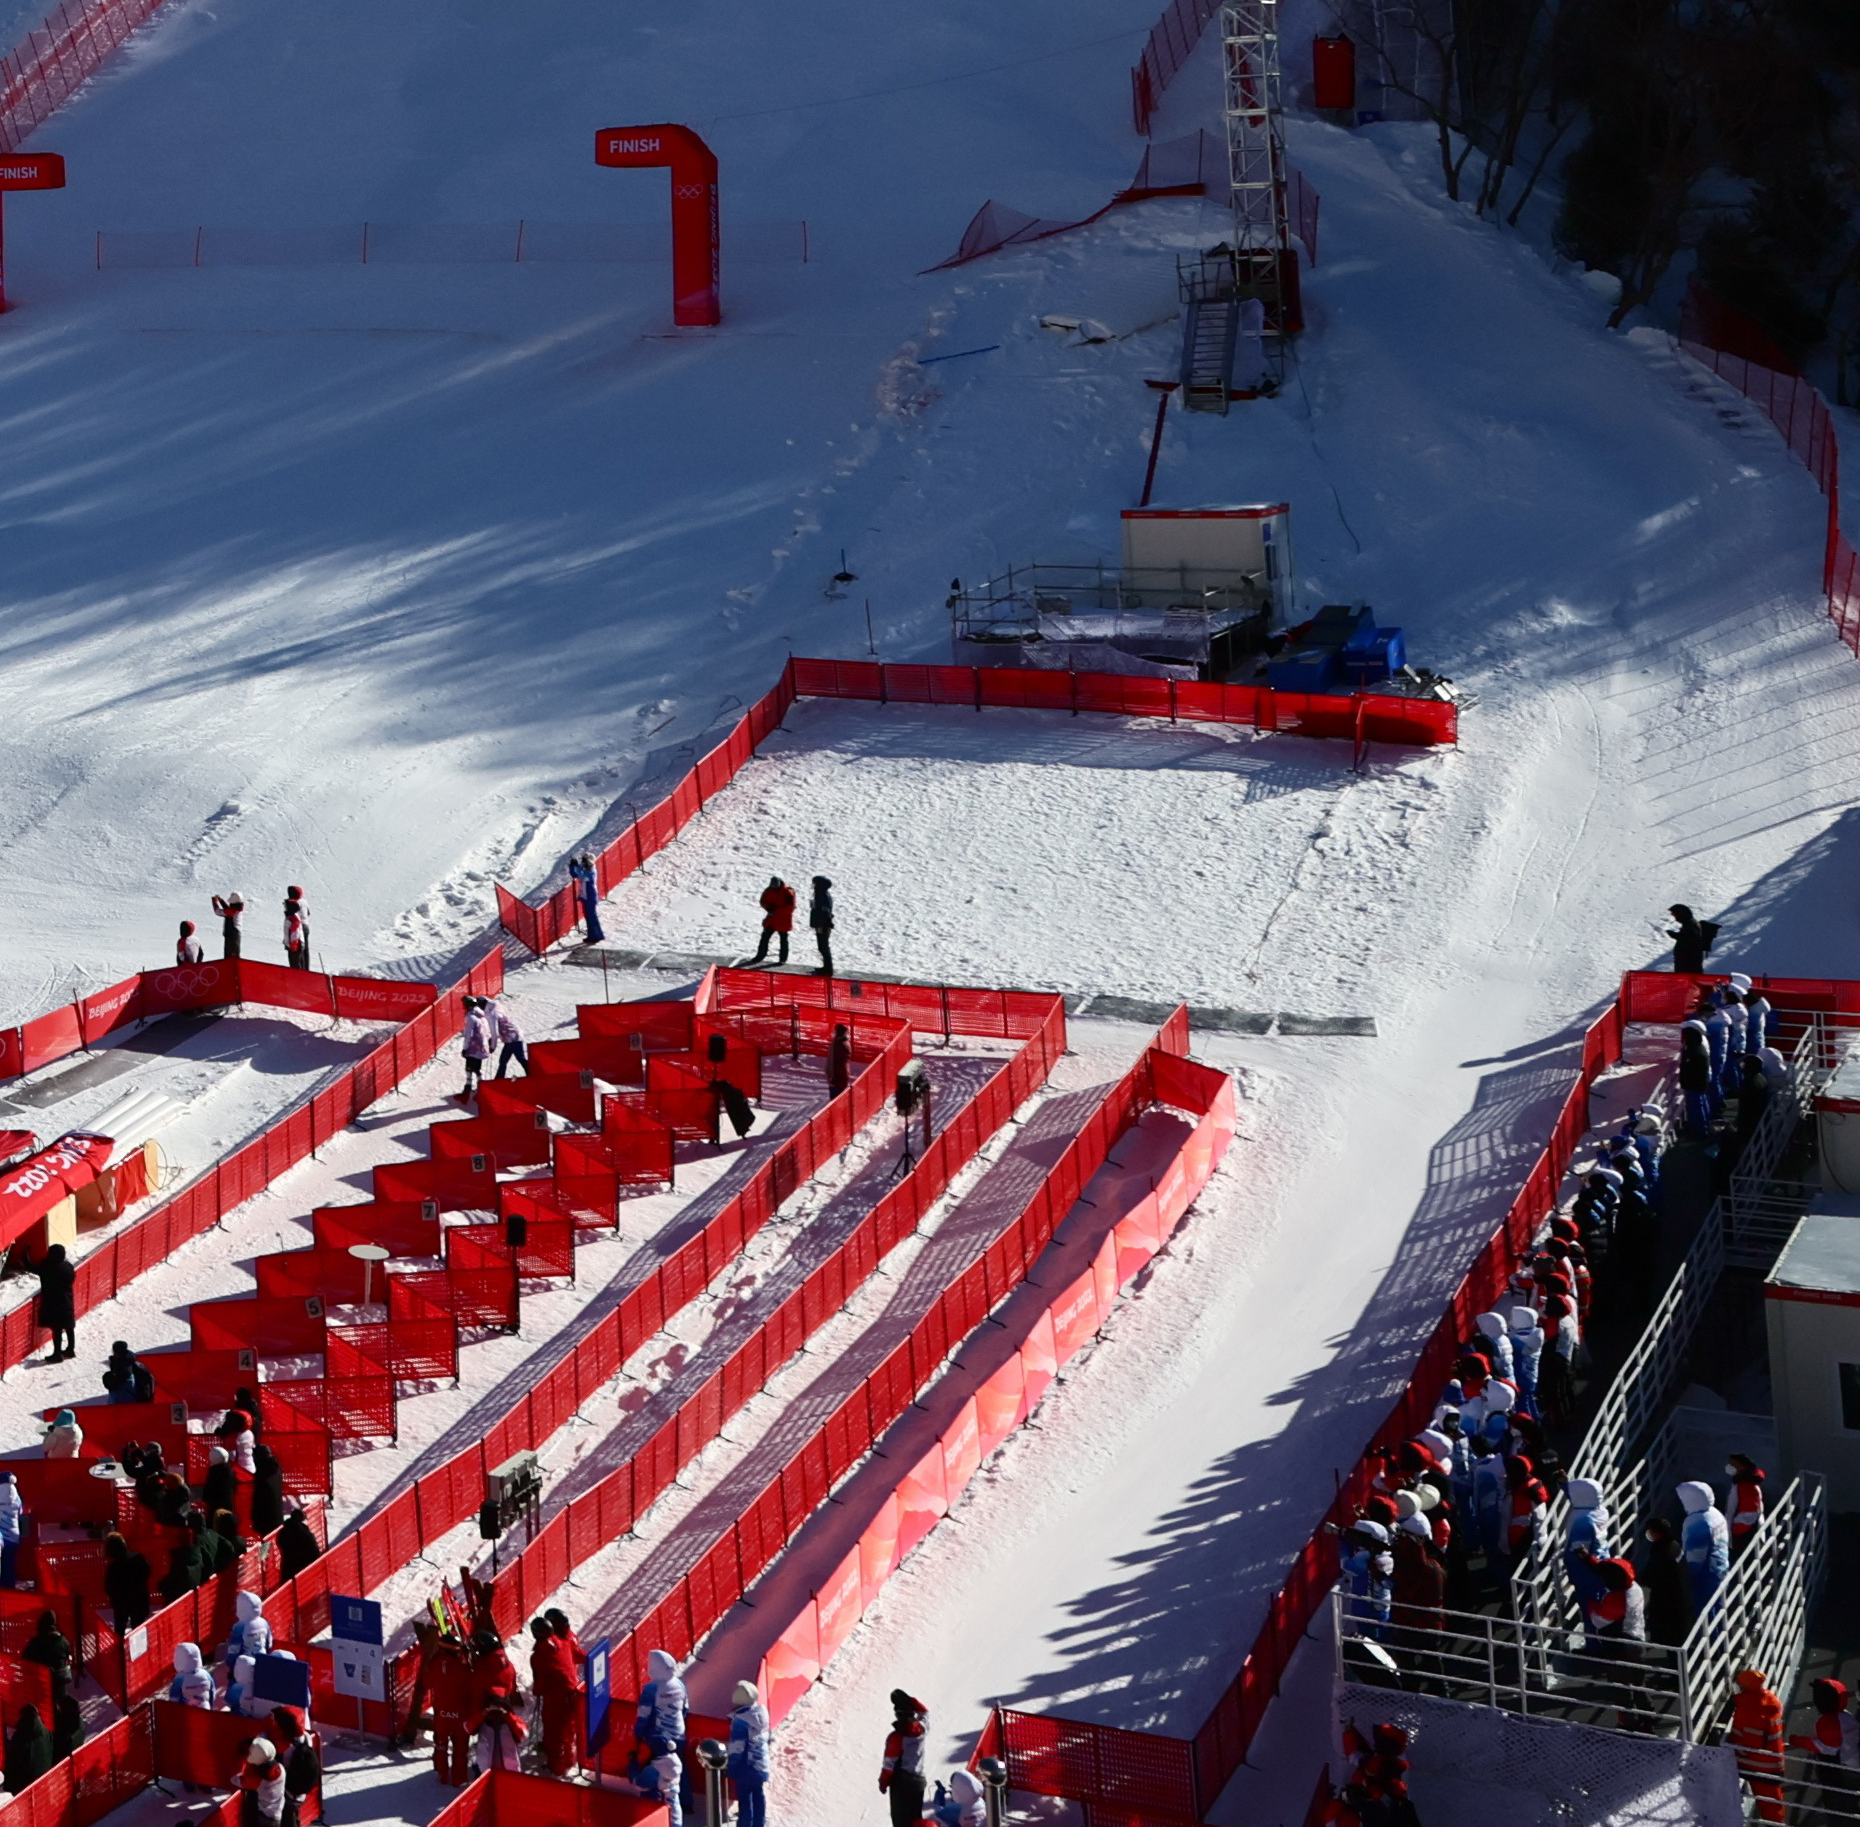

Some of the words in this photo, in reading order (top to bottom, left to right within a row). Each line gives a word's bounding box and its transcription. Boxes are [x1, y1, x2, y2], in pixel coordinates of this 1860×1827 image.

[610, 138, 660, 153] FINISH
[338, 986, 387, 1003] BEIJING
[391, 991, 429, 1004] 2022
[89, 996, 119, 1020] BEIJING
[474, 1156, 481, 1171] 8
[425, 1204, 435, 1219] 7
[309, 1300, 321, 1315] 5
[439, 1710, 460, 1720] CAN
